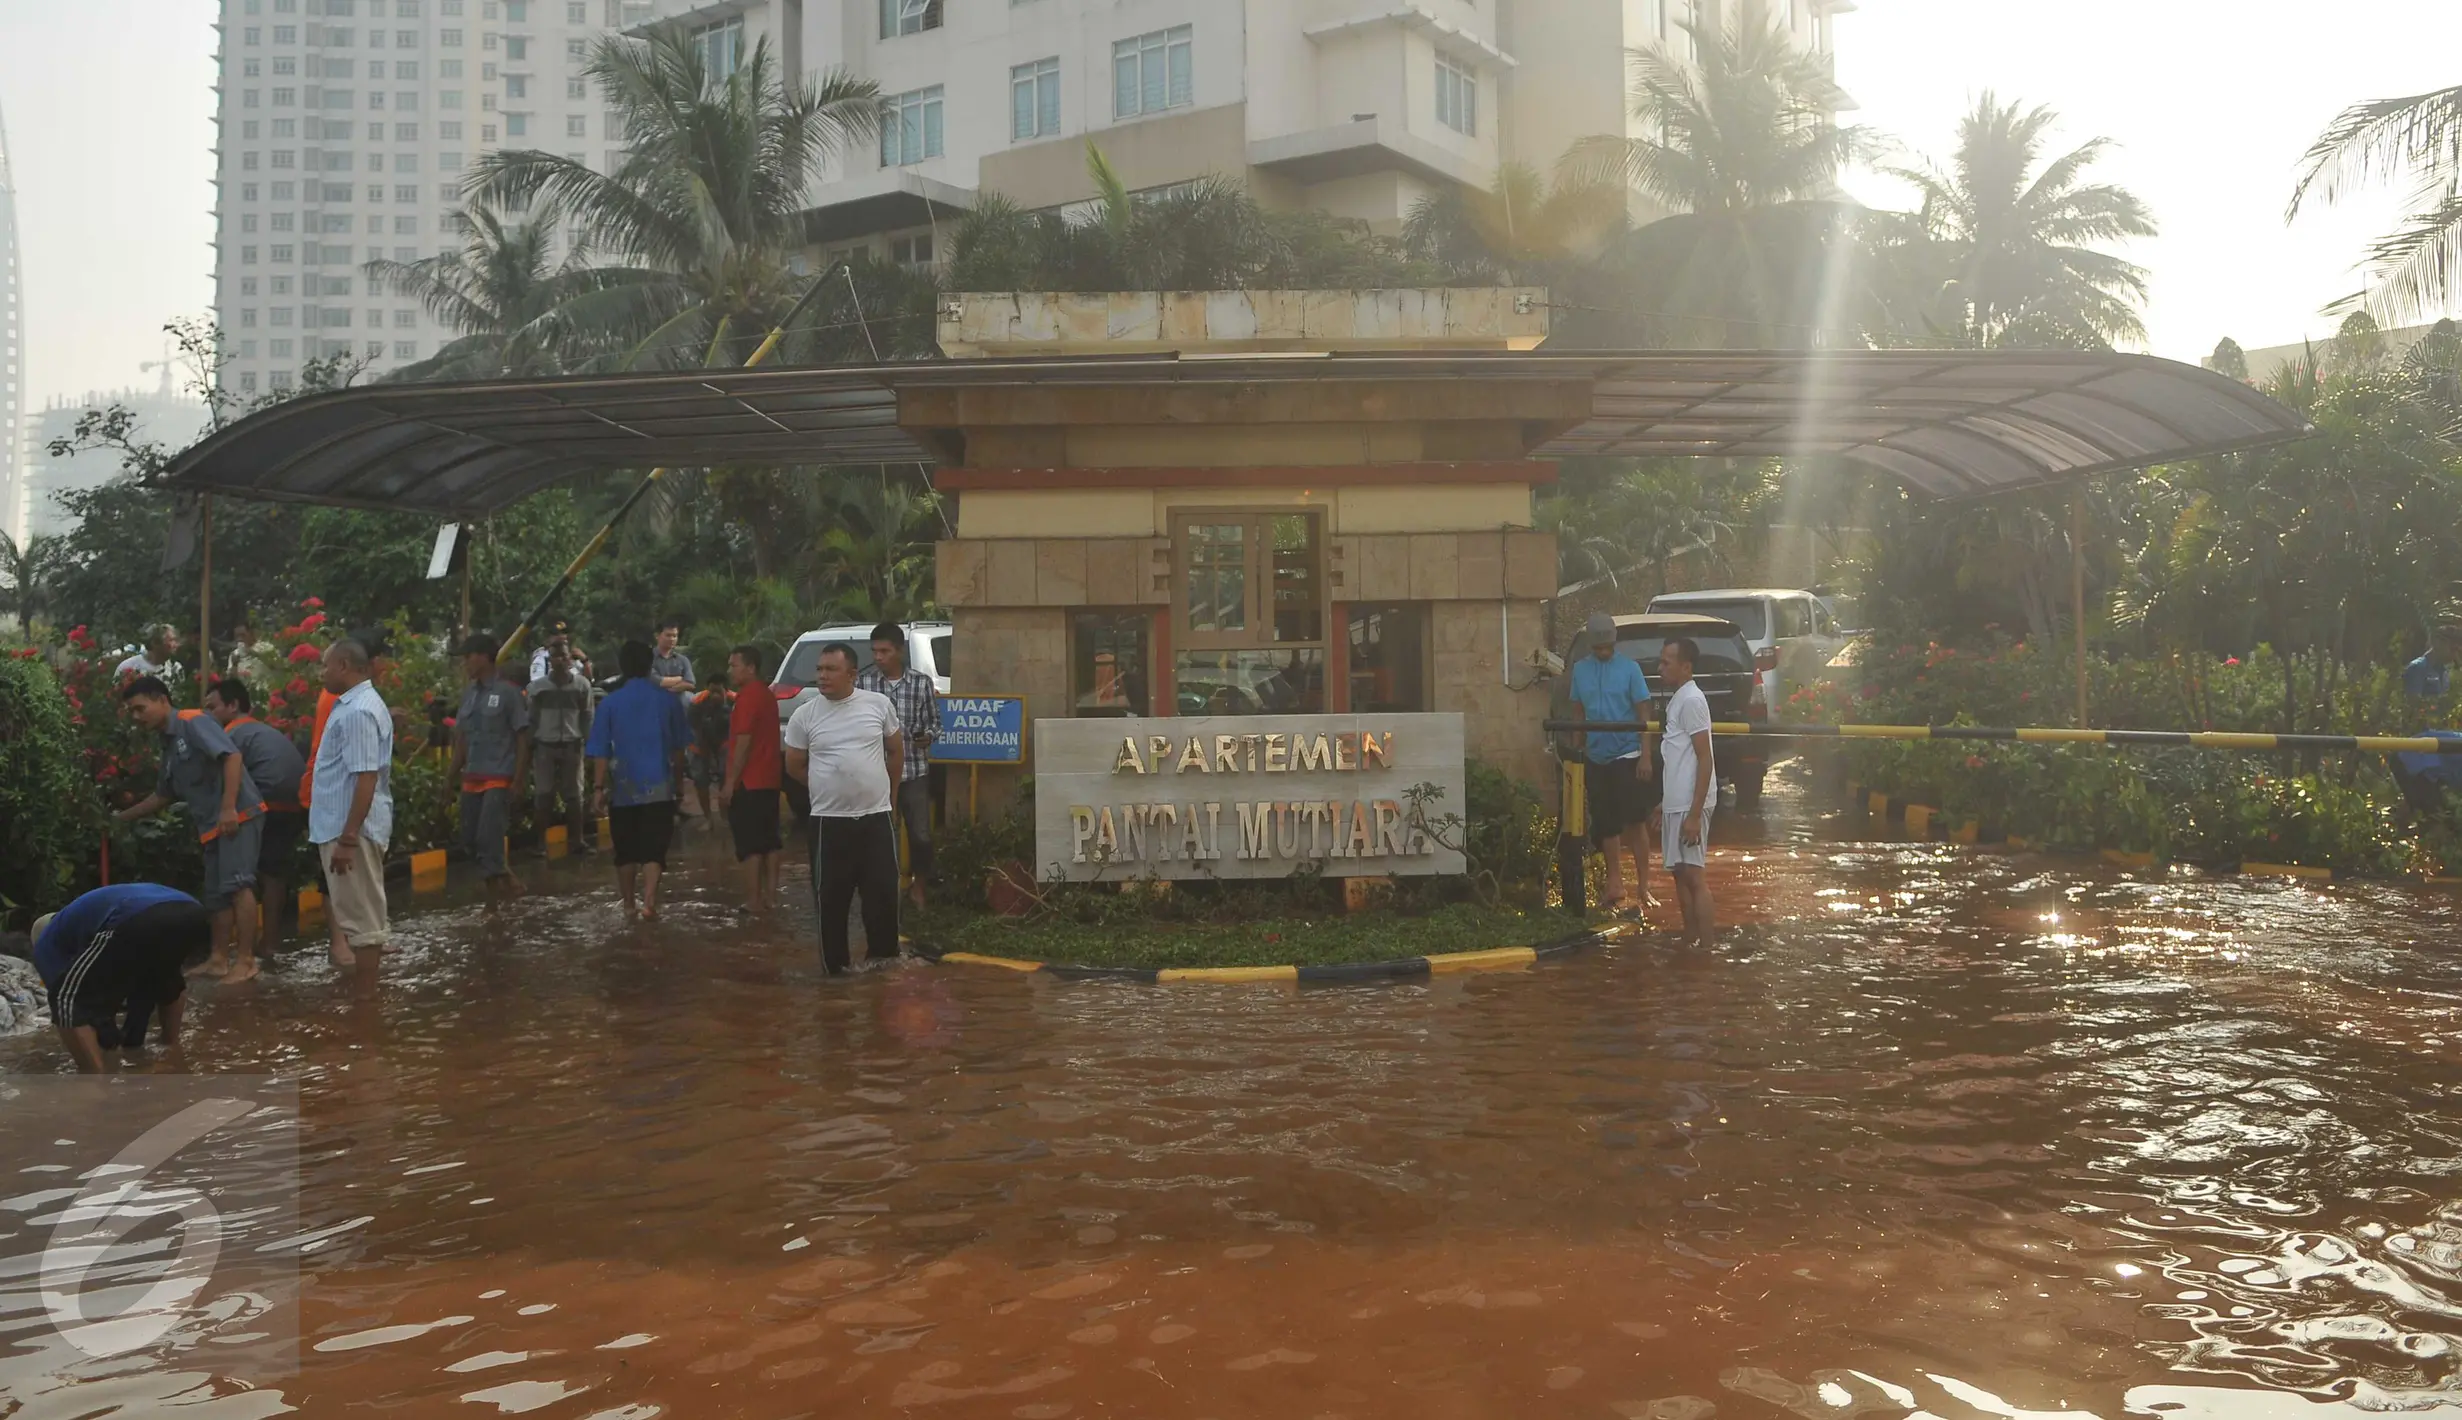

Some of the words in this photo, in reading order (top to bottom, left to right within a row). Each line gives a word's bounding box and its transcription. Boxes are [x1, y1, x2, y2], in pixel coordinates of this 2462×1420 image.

[947, 699, 1005, 713] MAAF
[953, 715, 997, 729] ADA
[937, 731, 1019, 745] EMERIKSAAN
[1111, 732, 1393, 774] APARTEMEN
[1069, 801, 1221, 864] PANTAI
[1235, 799, 1435, 859] MUTIARA
